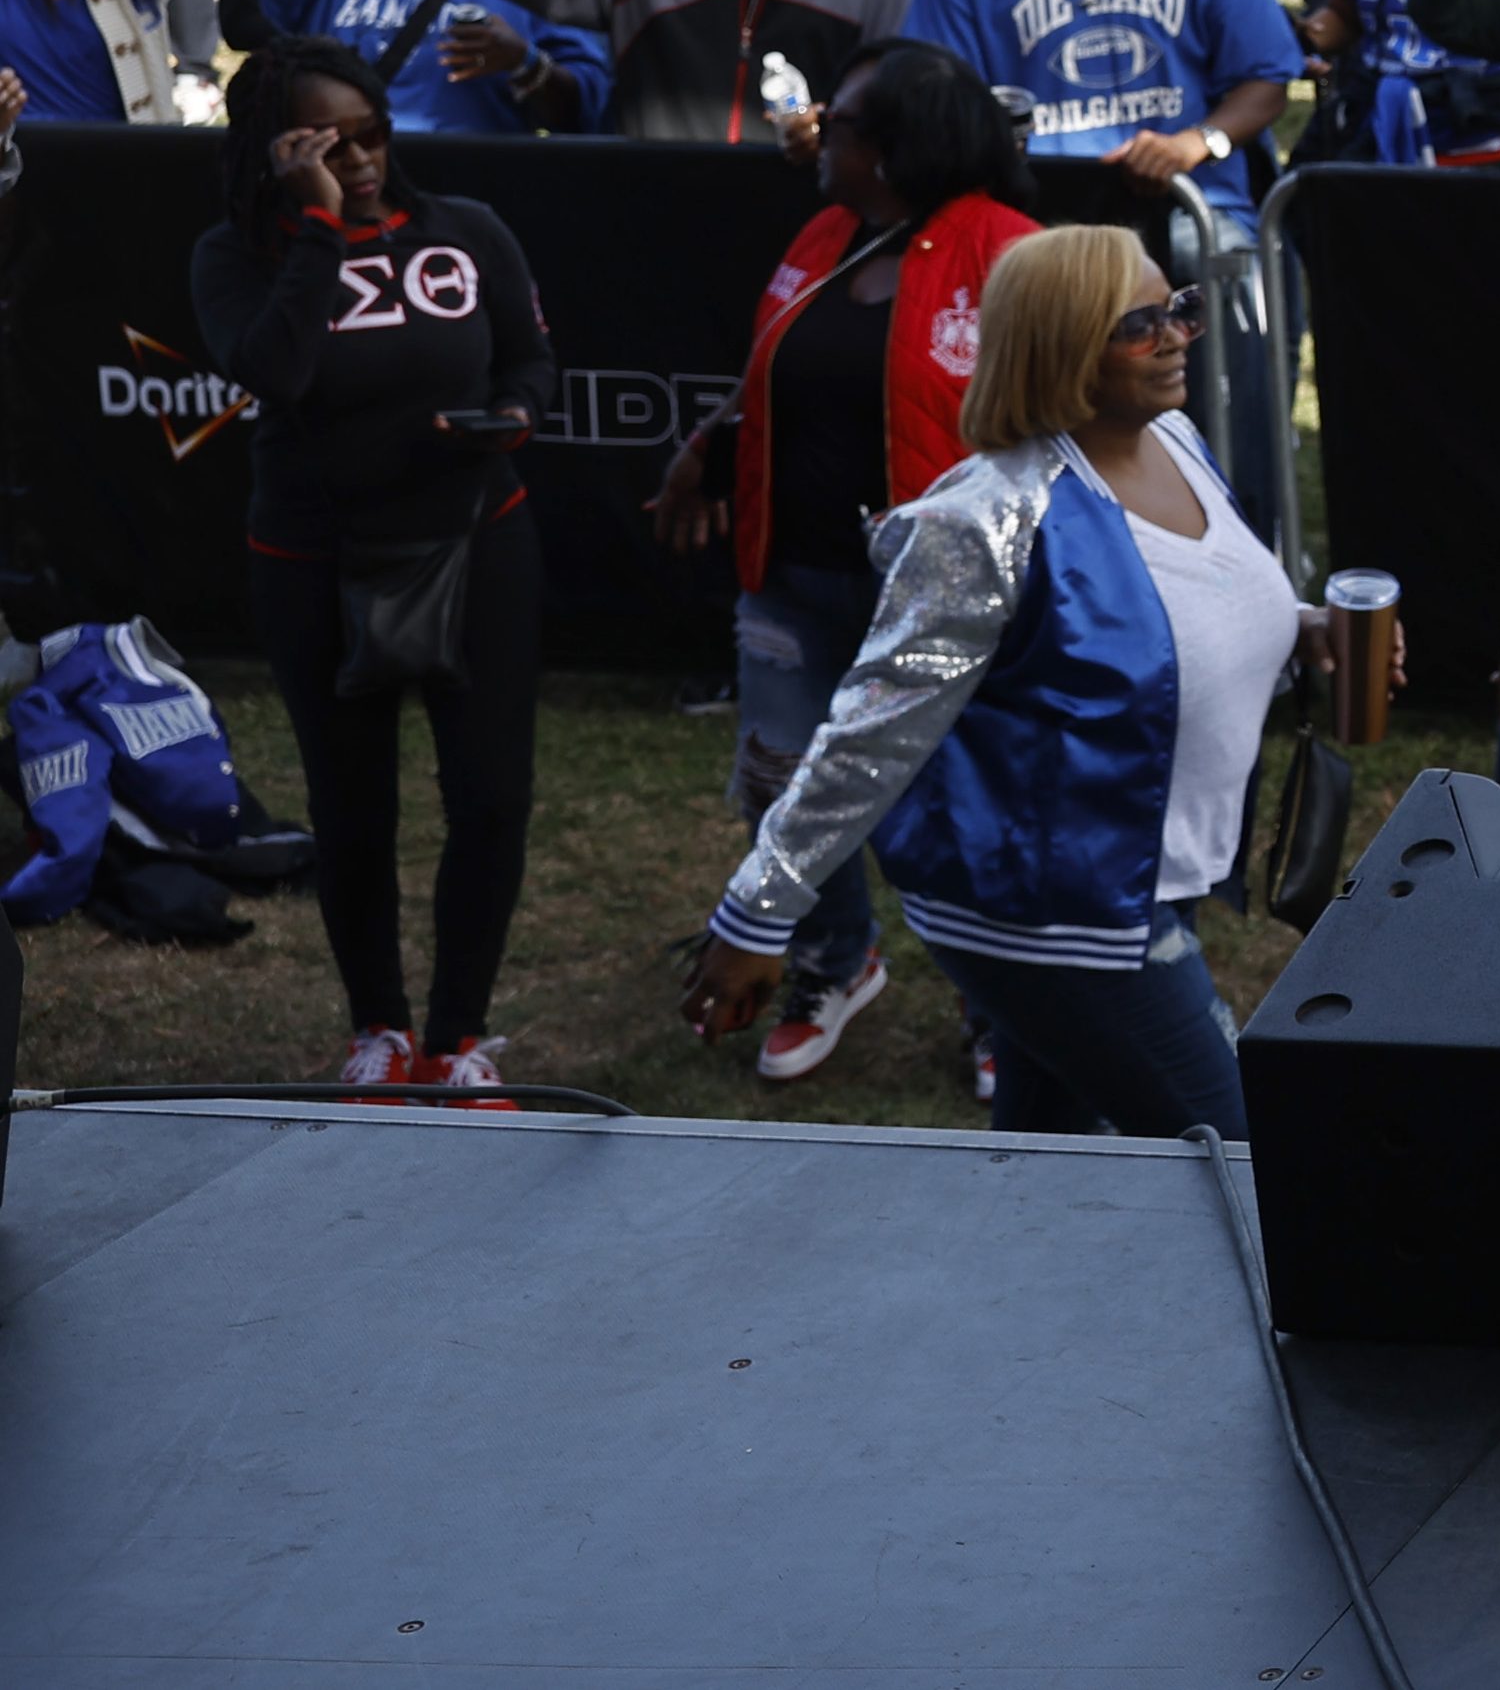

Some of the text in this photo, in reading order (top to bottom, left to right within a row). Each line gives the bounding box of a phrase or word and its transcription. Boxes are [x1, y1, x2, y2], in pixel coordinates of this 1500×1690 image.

[1032, 86, 1184, 136] TAILGATERS
[328, 245, 479, 332] ΣΘ
[97, 365, 261, 421] Dorito
